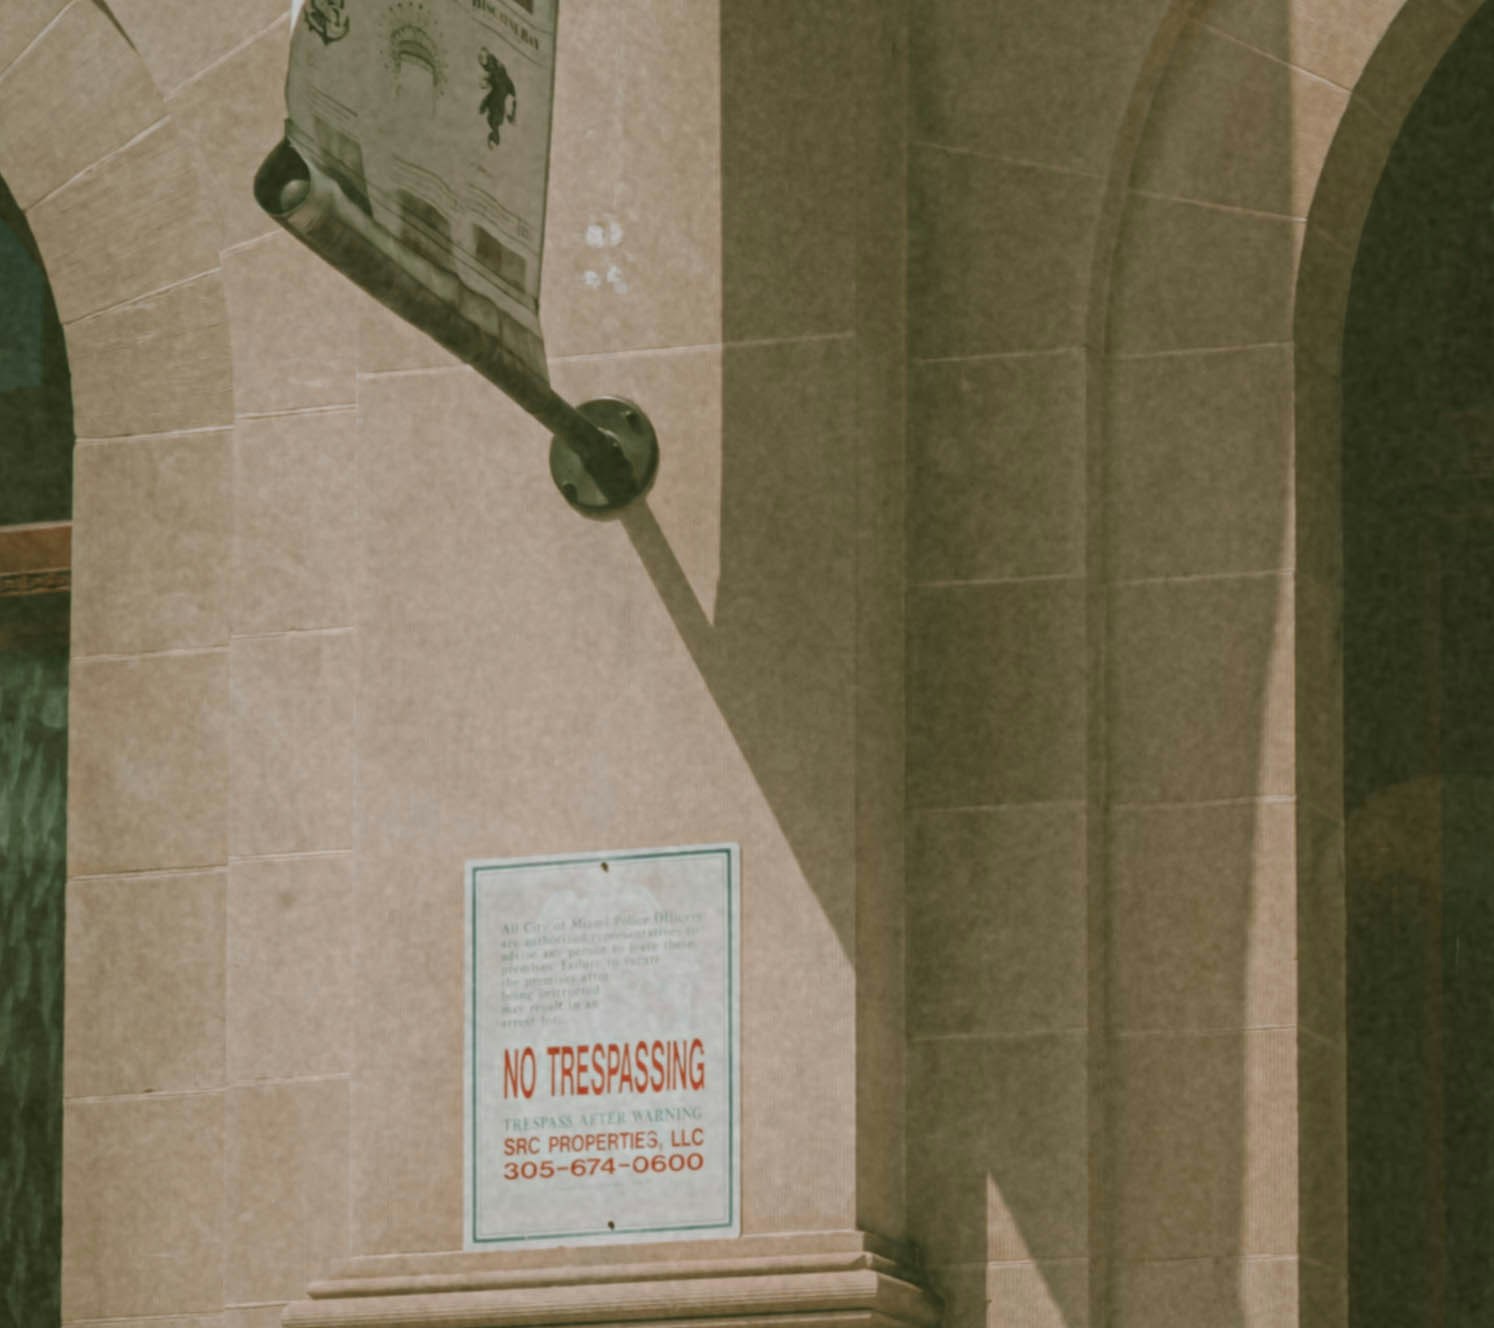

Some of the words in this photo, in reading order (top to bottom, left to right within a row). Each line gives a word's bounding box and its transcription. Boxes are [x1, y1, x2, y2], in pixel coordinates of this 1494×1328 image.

[504, 1045, 537, 1099] NO
[547, 1038, 705, 1097] TRESPASSING
[504, 1114, 574, 1132] TRESPASS
[580, 1110, 625, 1127] AFTER
[633, 1106, 703, 1123] WARNING
[504, 1136, 541, 1156] SRC
[549, 1130, 664, 1152] PROPERTIES,
[671, 1127, 705, 1147] LLC
[504, 1152, 705, 1180] 305-674-0600
